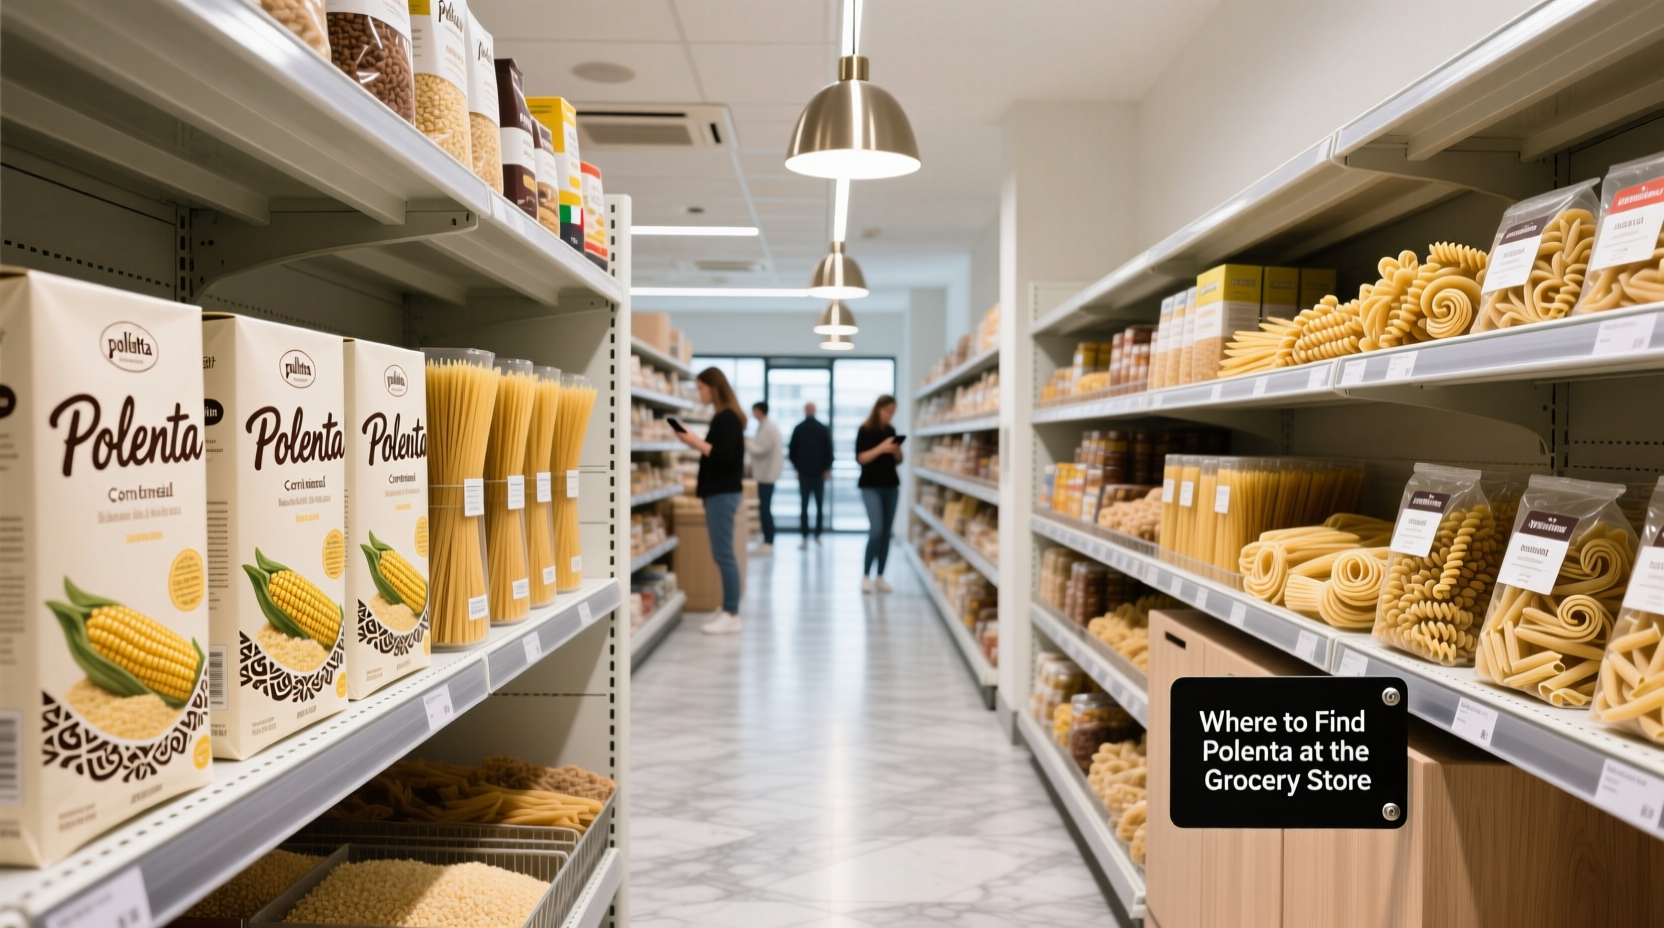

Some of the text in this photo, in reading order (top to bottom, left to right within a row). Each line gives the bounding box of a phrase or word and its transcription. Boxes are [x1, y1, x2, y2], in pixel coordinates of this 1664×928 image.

[49, 394, 203, 477] Polenta
[245, 406, 345, 471] Polenta
[361, 412, 427, 466] Polenta
[1199, 709, 1365, 733] Where to Find
[1203, 739, 1369, 762] Polenta at the
[1204, 768, 1372, 797] Grocery Store
